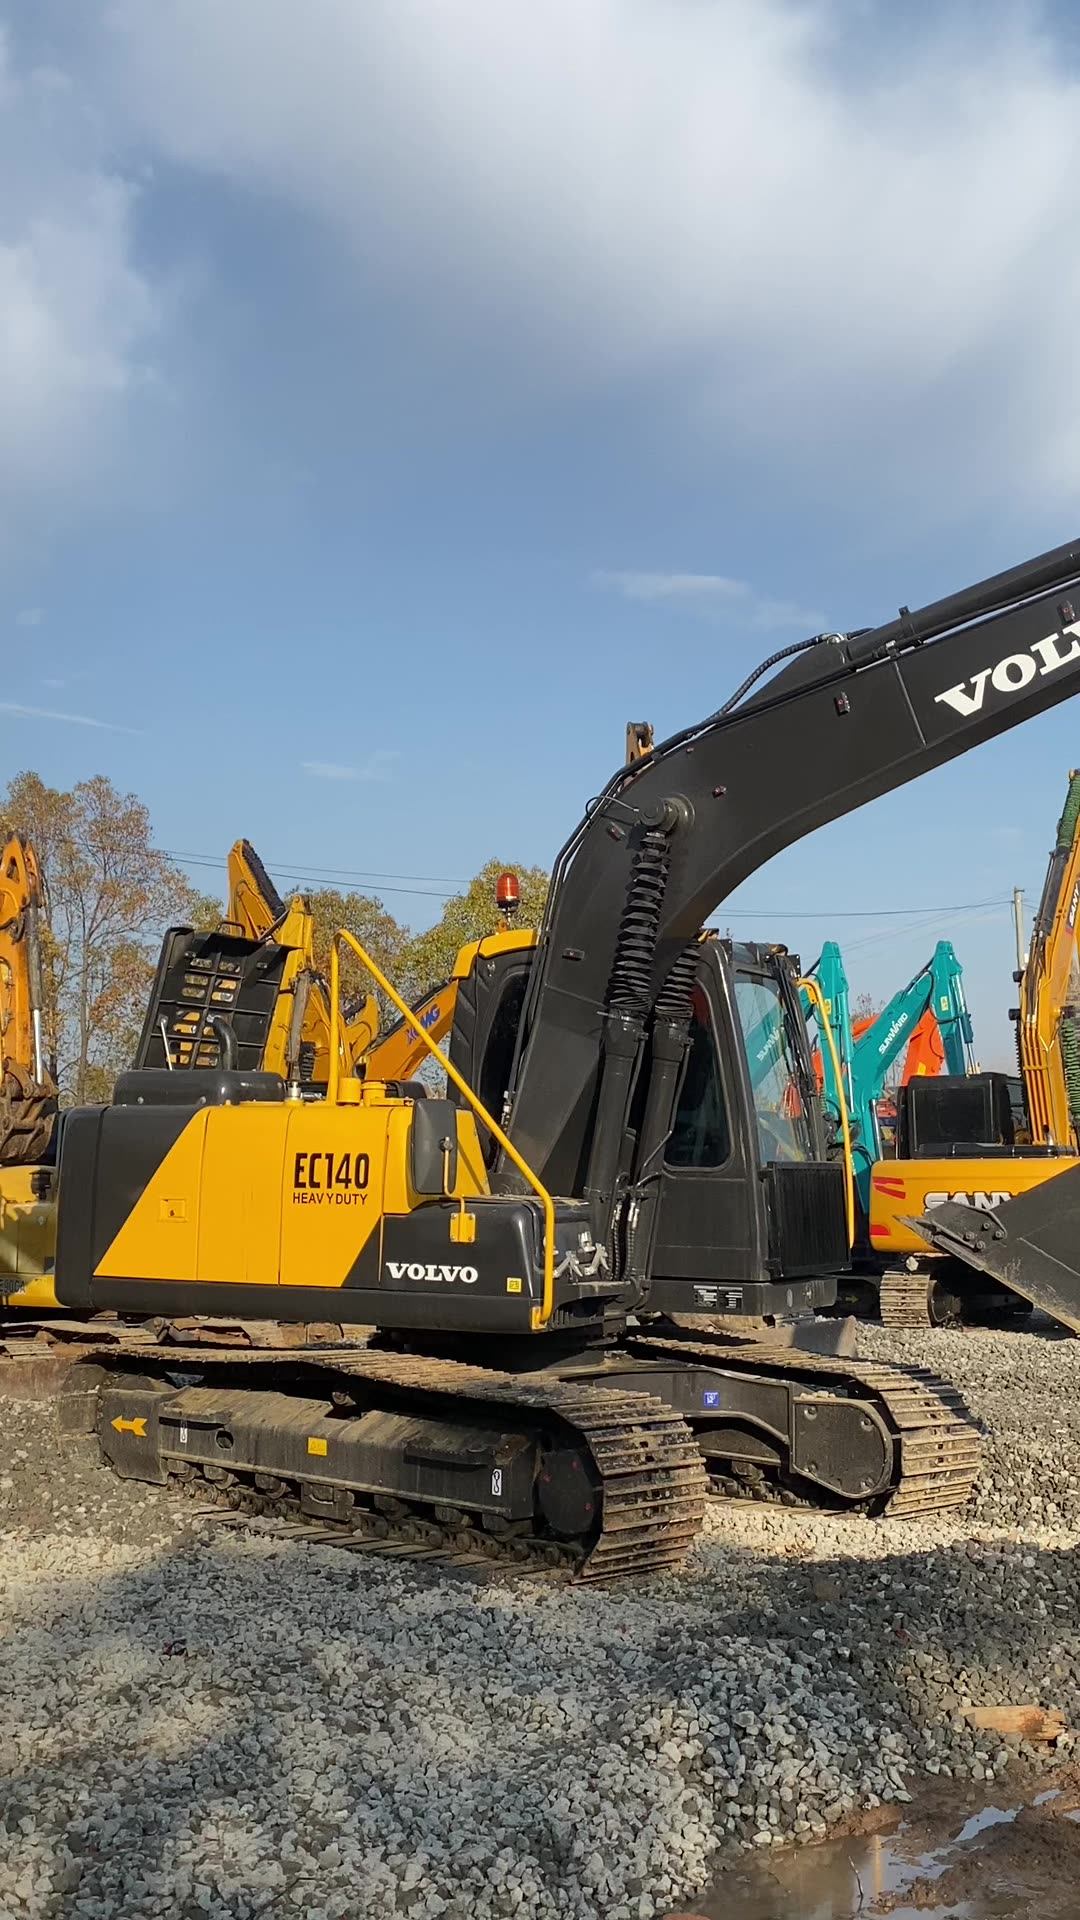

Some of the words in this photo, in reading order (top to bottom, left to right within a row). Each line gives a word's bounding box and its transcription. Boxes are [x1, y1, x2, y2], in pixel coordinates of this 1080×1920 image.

[878, 1012, 908, 1055] SUNWARD
[294, 1152, 370, 1190] EC140
[292, 1192, 334, 1205] HEAVY
[335, 1193, 368, 1206] DUTY
[385, 1261, 479, 1284] VOLVO
